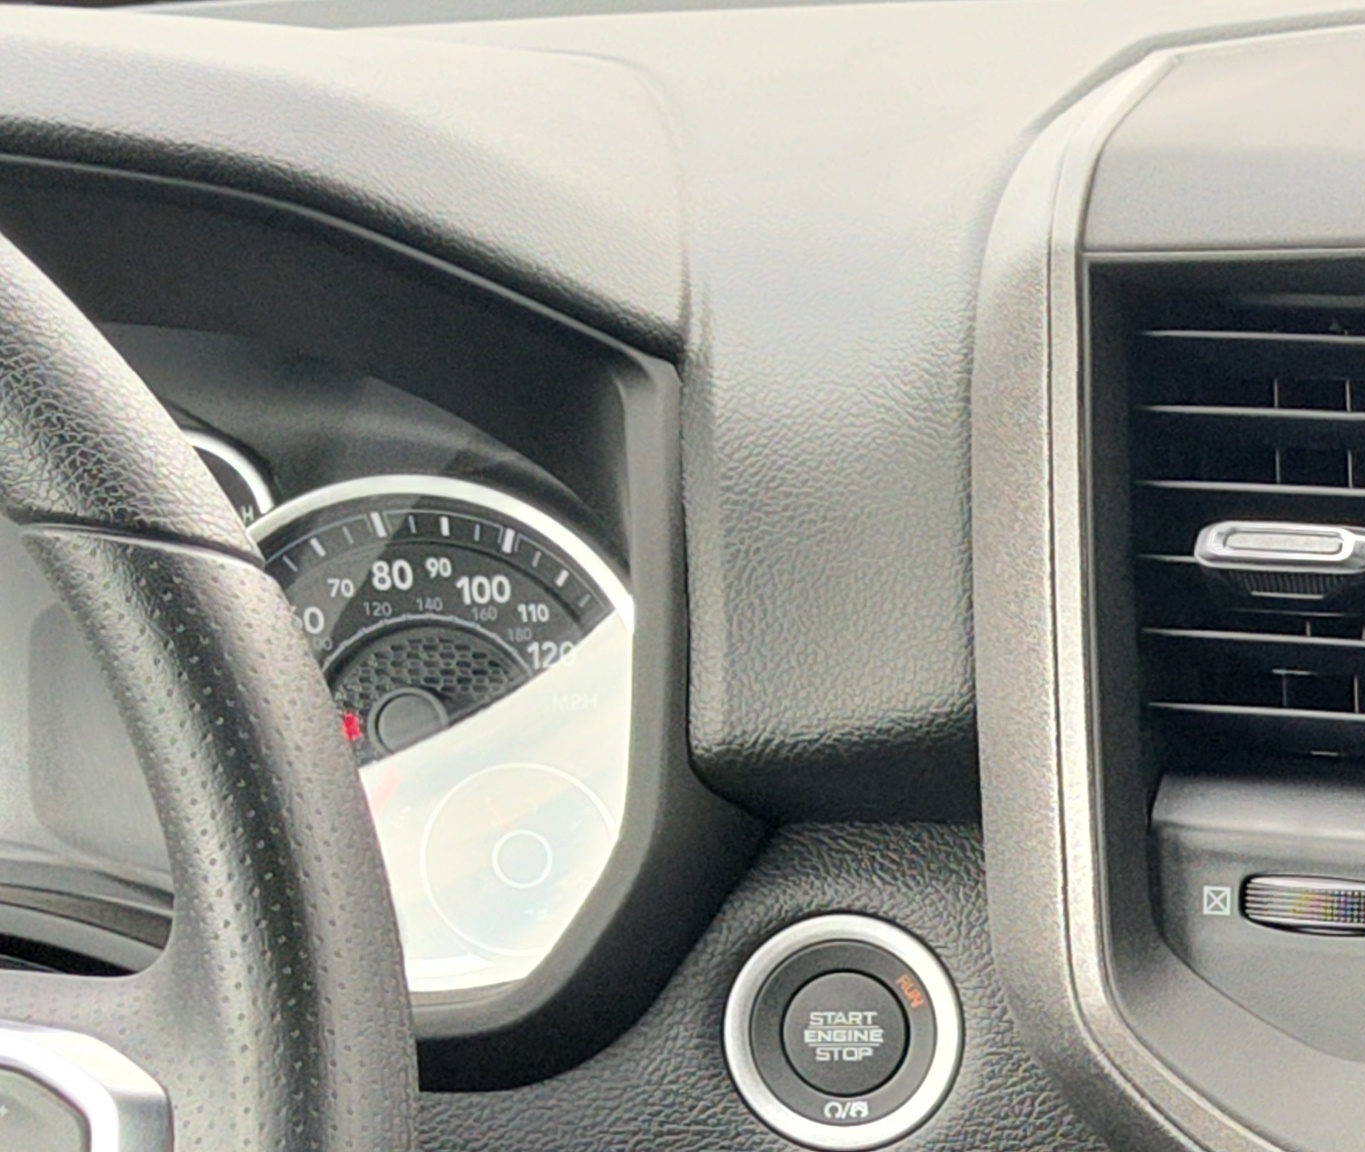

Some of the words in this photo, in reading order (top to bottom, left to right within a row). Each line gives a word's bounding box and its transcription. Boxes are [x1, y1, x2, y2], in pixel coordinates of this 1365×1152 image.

[371, 559, 413, 591] 80
[425, 557, 452, 578] 90
[327, 577, 354, 598] 70
[455, 574, 511, 605] 100
[363, 601, 392, 618] 120
[416, 597, 443, 612] 140
[471, 606, 497, 621] 160
[516, 603, 549, 623] 110
[507, 627, 532, 641] 180
[526, 640, 575, 669] 120
[896, 974, 924, 1008] RUN
[809, 1011, 877, 1026] START
[803, 1029, 884, 1043] ENGINE
[815, 1047, 874, 1061] STOP
